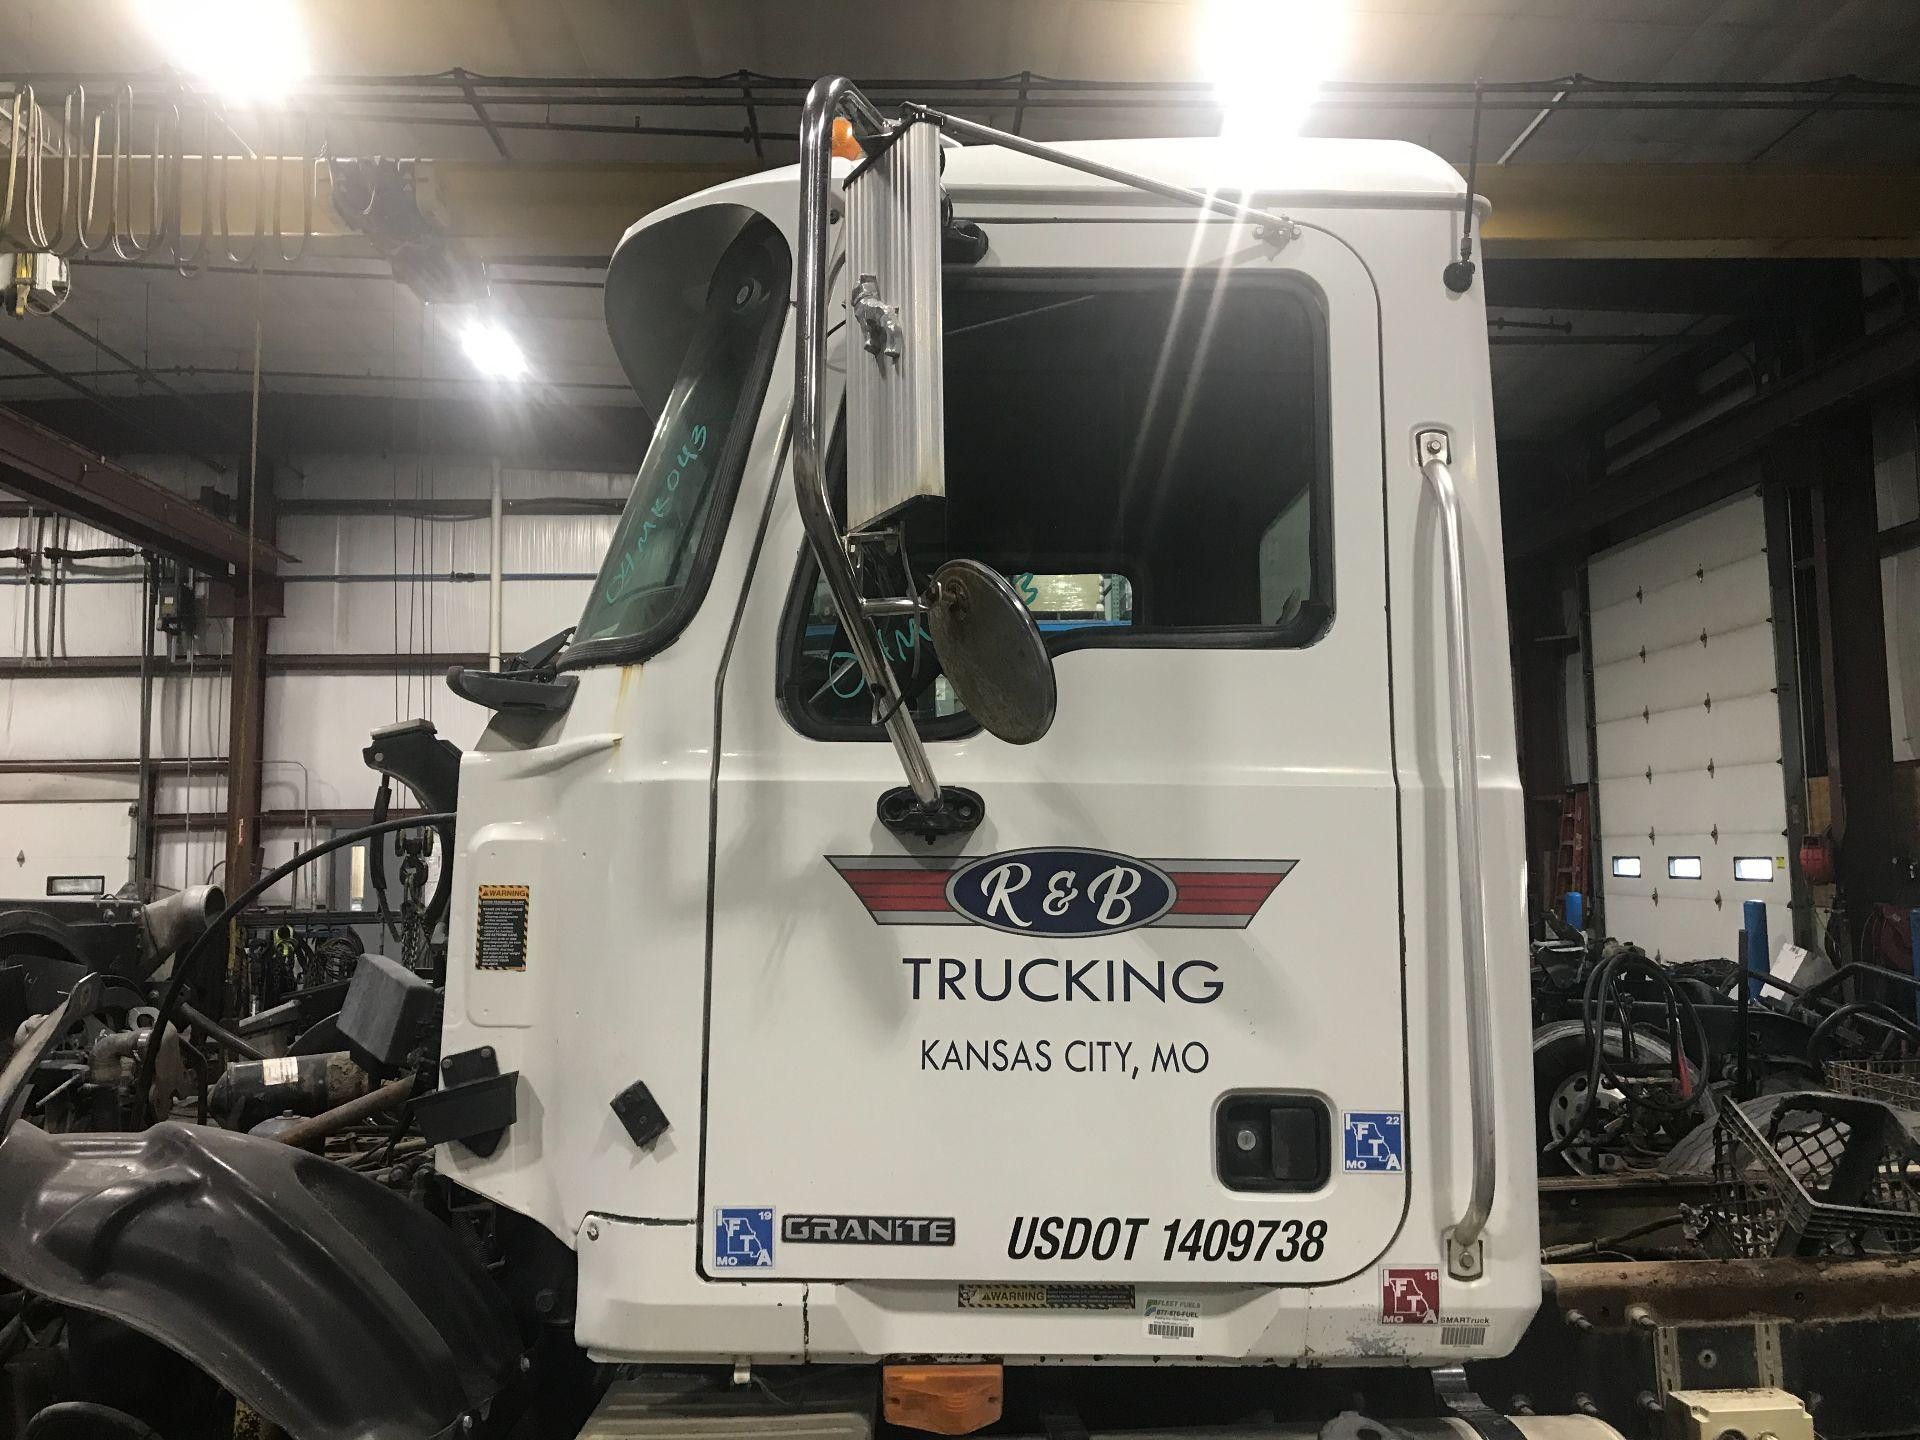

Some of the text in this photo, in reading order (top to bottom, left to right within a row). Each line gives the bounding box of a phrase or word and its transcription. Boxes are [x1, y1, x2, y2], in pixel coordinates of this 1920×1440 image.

[490, 889, 526, 897] WARNING
[902, 957, 1225, 1004] TRUCKING
[920, 1039, 1209, 1080] KANSAS CITY, MO
[1385, 1116, 1400, 1125] 22
[1346, 1160, 1367, 1169] MO
[758, 1211, 772, 1221] 19
[1006, 1216, 1329, 1263] USDOT 1409738
[717, 1256, 738, 1266] MO
[1424, 1271, 1438, 1281] 18
[989, 1291, 1045, 1301] WARNING
[1382, 1315, 1404, 1324] MO
[1440, 1316, 1490, 1324] SMARTruck
